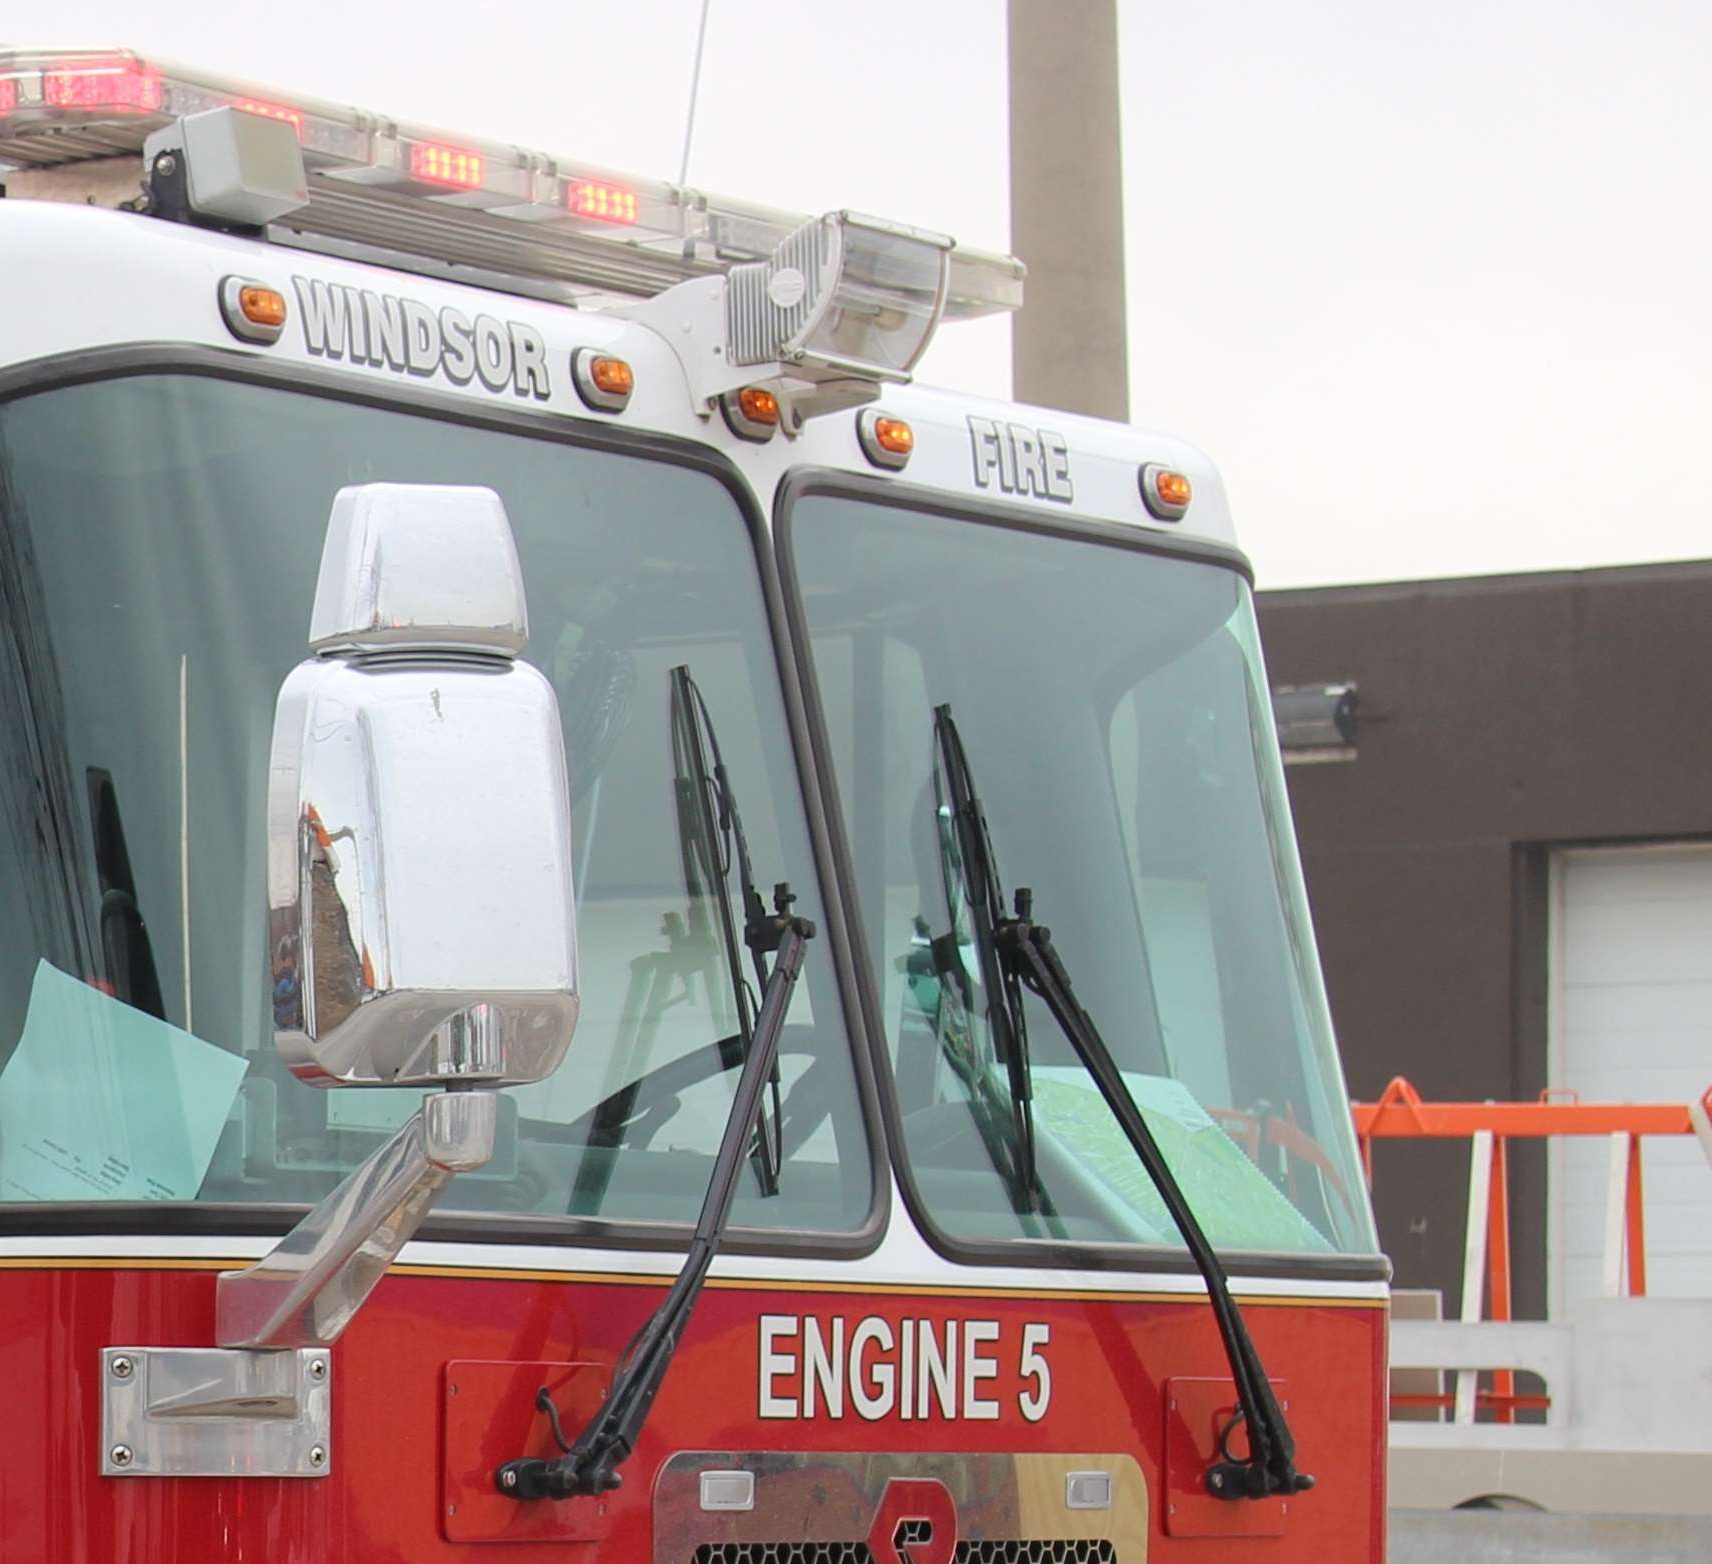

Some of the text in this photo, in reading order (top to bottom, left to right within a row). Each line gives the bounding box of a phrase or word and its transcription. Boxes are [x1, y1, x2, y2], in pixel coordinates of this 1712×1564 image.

[291, 274, 552, 400] WINDSOR
[970, 413, 1075, 504] FIRE
[757, 1313, 1052, 1422] ENGINE 5
